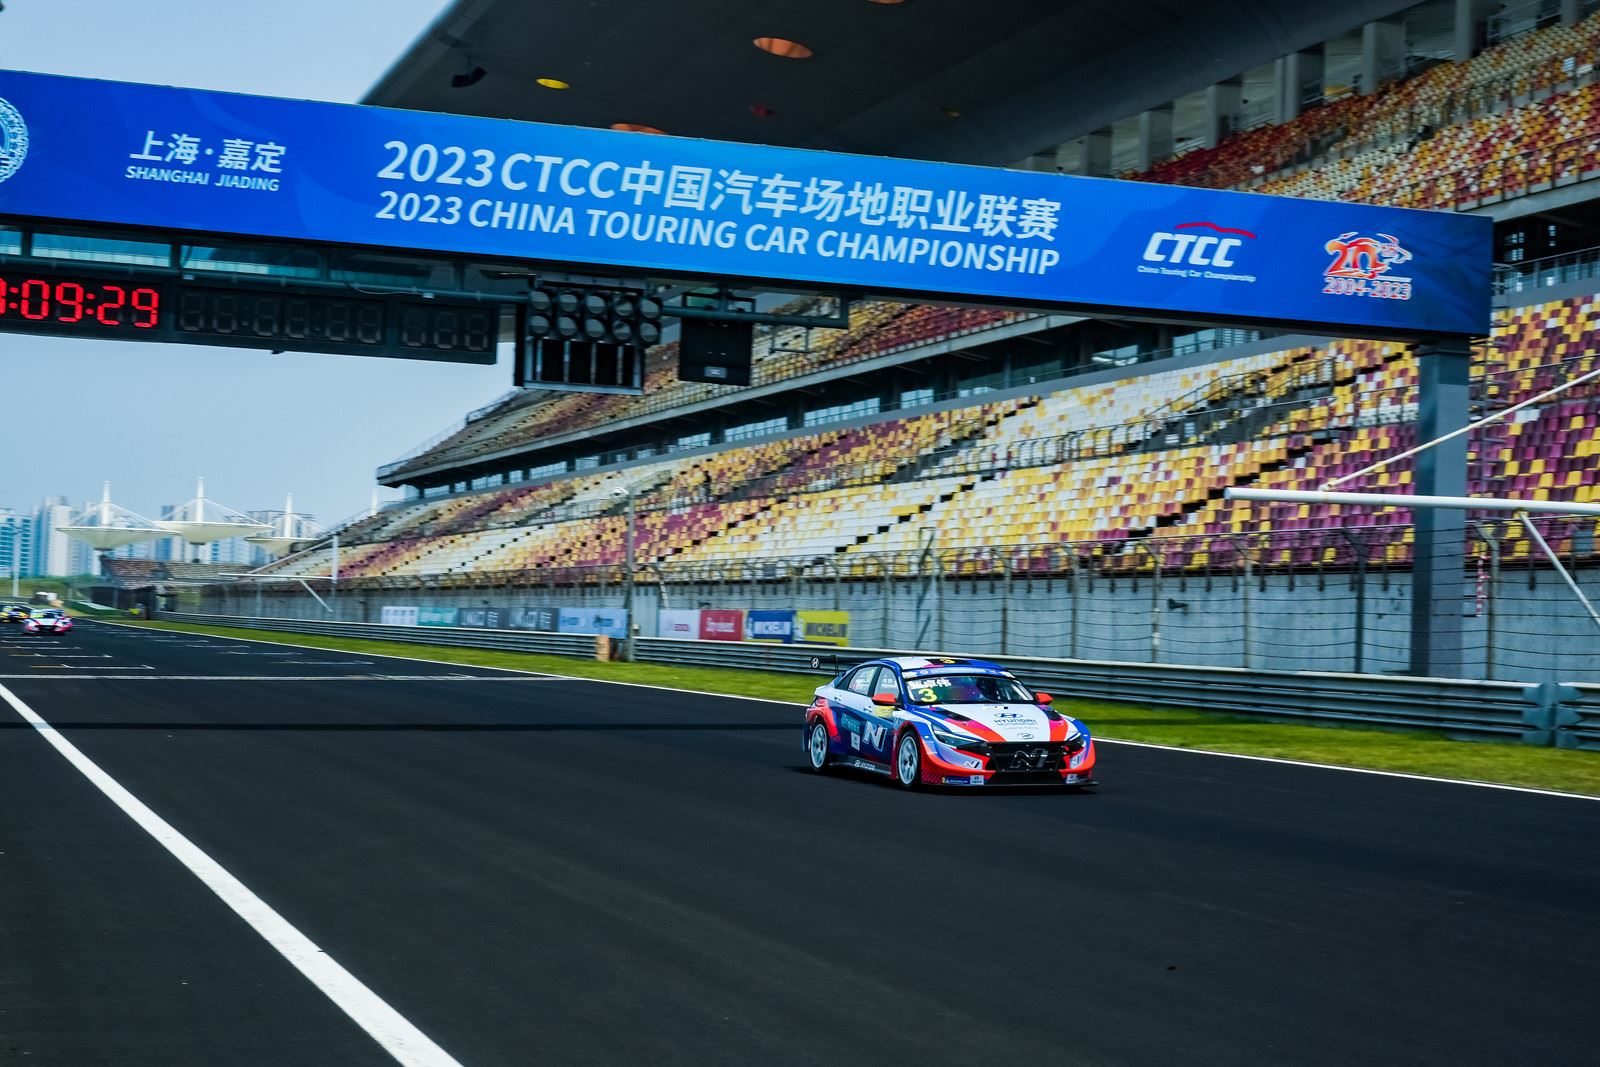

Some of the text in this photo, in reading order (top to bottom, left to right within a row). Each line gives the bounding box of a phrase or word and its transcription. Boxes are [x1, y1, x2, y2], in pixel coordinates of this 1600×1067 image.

[126, 131, 287, 174] 上海·嘉定
[125, 165, 280, 193] SHANGHAI JIADING
[375, 190, 1060, 275] 2023 CHINA TOURING CAR CHAMPIONSHIP
[1143, 231, 1242, 268] CTCC
[0, 278, 159, 328] :09:29
[1322, 276, 1413, 300] 2004-2023
[918, 688, 938, 703] 3
